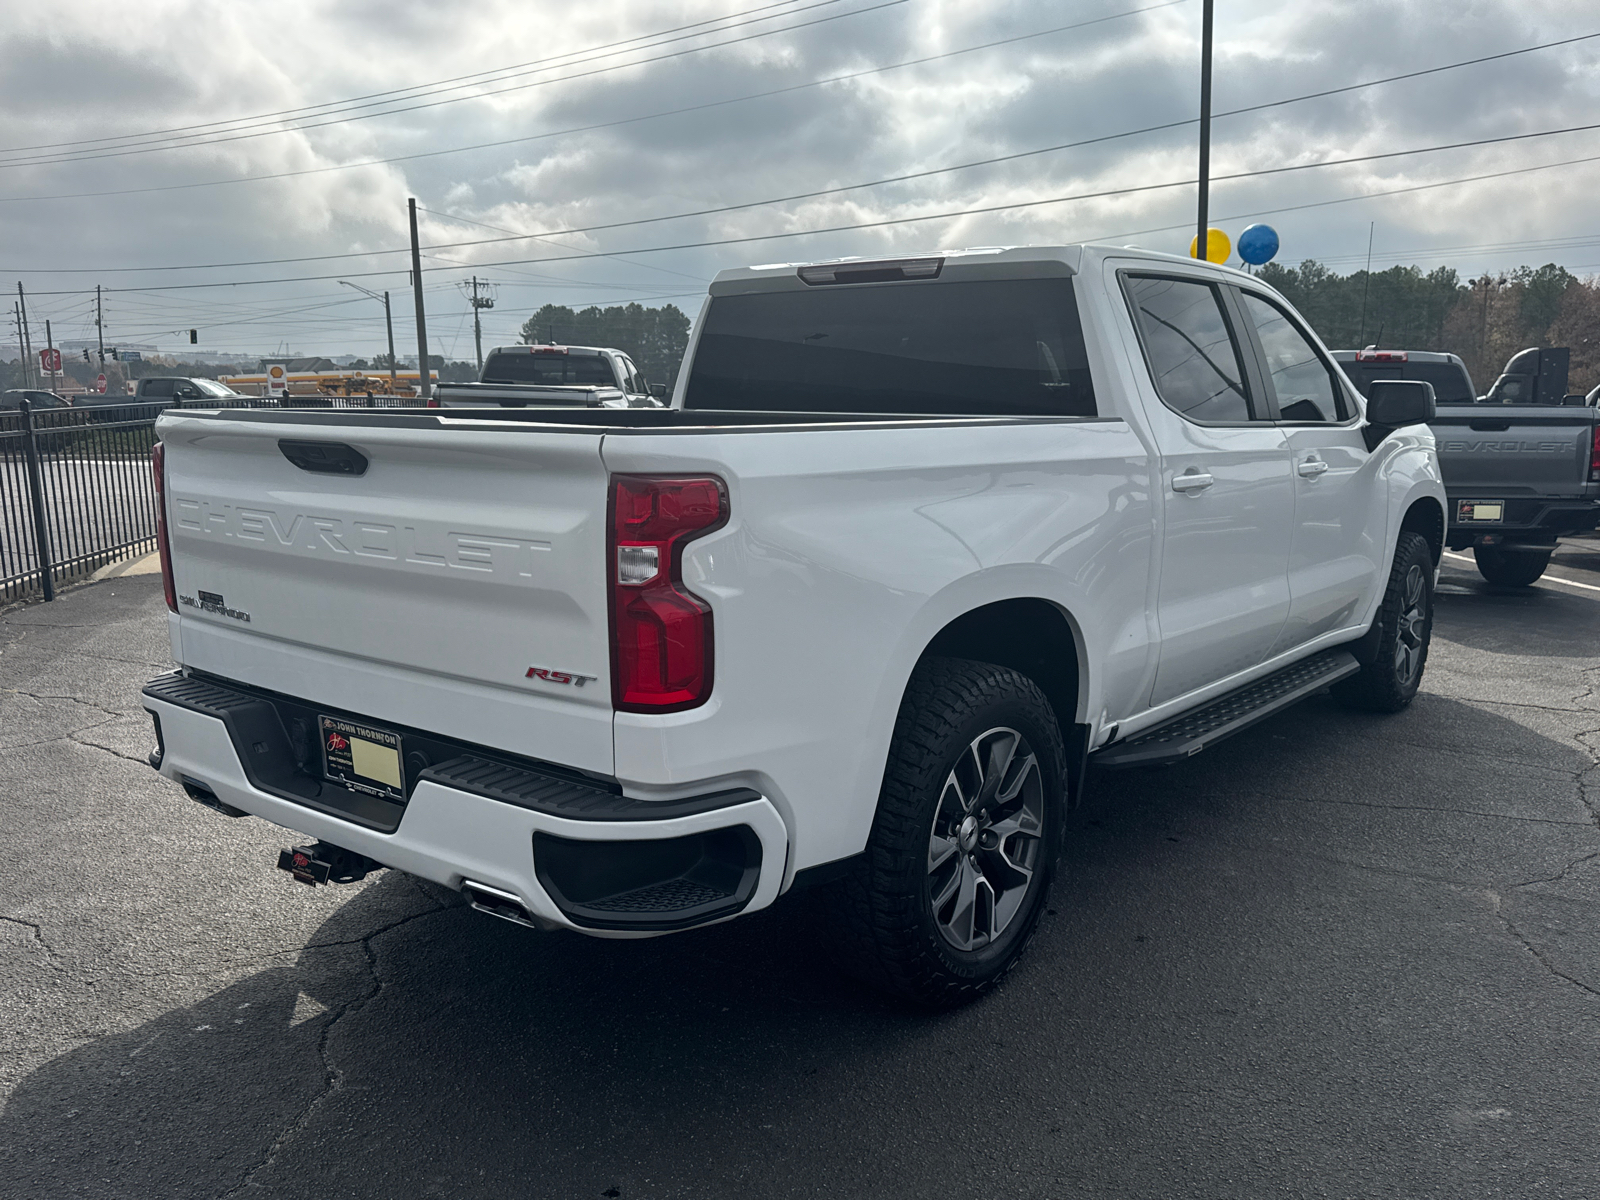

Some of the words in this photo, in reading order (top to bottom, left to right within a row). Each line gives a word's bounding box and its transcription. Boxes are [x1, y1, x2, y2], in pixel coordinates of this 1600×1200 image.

[175, 498, 552, 577] CHEVROLET
[525, 666, 598, 688] RST
[337, 721, 355, 734] JOHN
[356, 727, 396, 745] THORNTON
[353, 784, 377, 796] CHEVROLET
